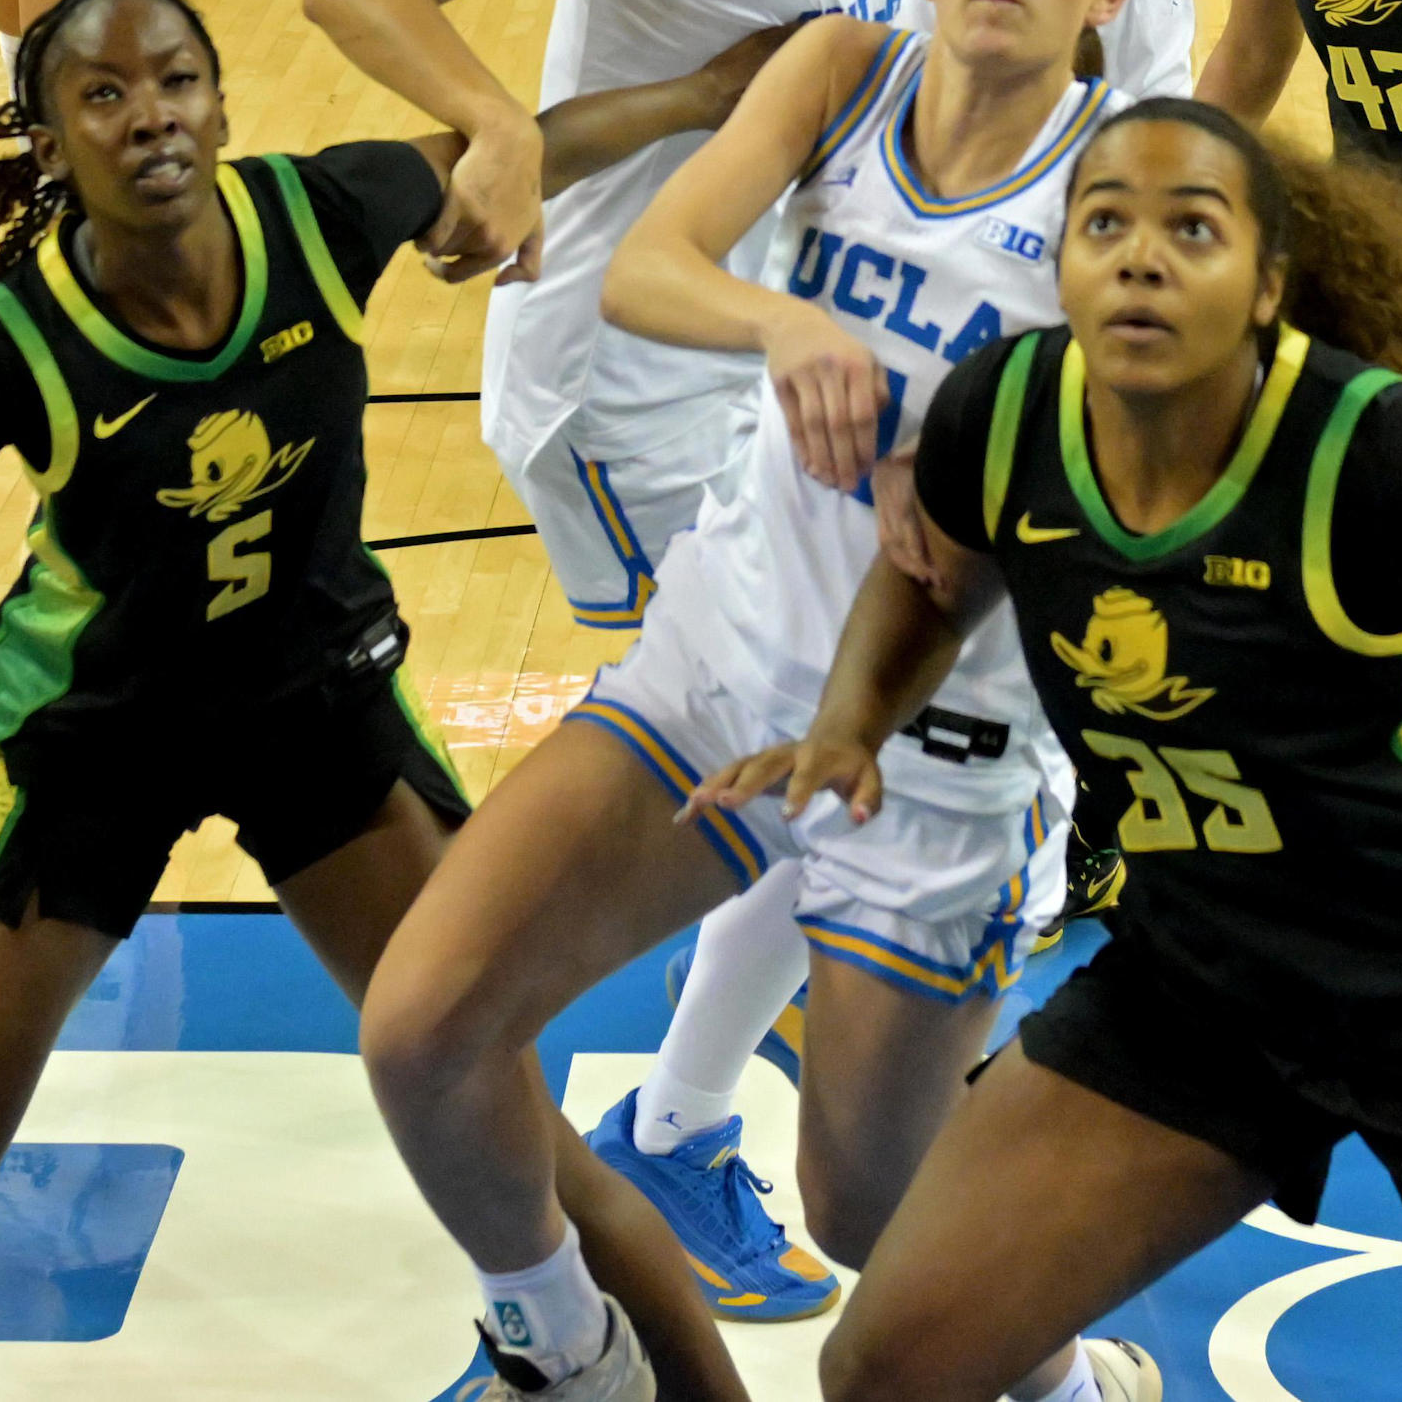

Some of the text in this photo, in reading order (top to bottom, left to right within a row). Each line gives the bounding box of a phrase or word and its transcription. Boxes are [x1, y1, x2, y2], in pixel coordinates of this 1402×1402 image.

[788, 227, 1002, 366] UCLA
[206, 508, 273, 623] 5
[1081, 728, 1285, 854] 35
